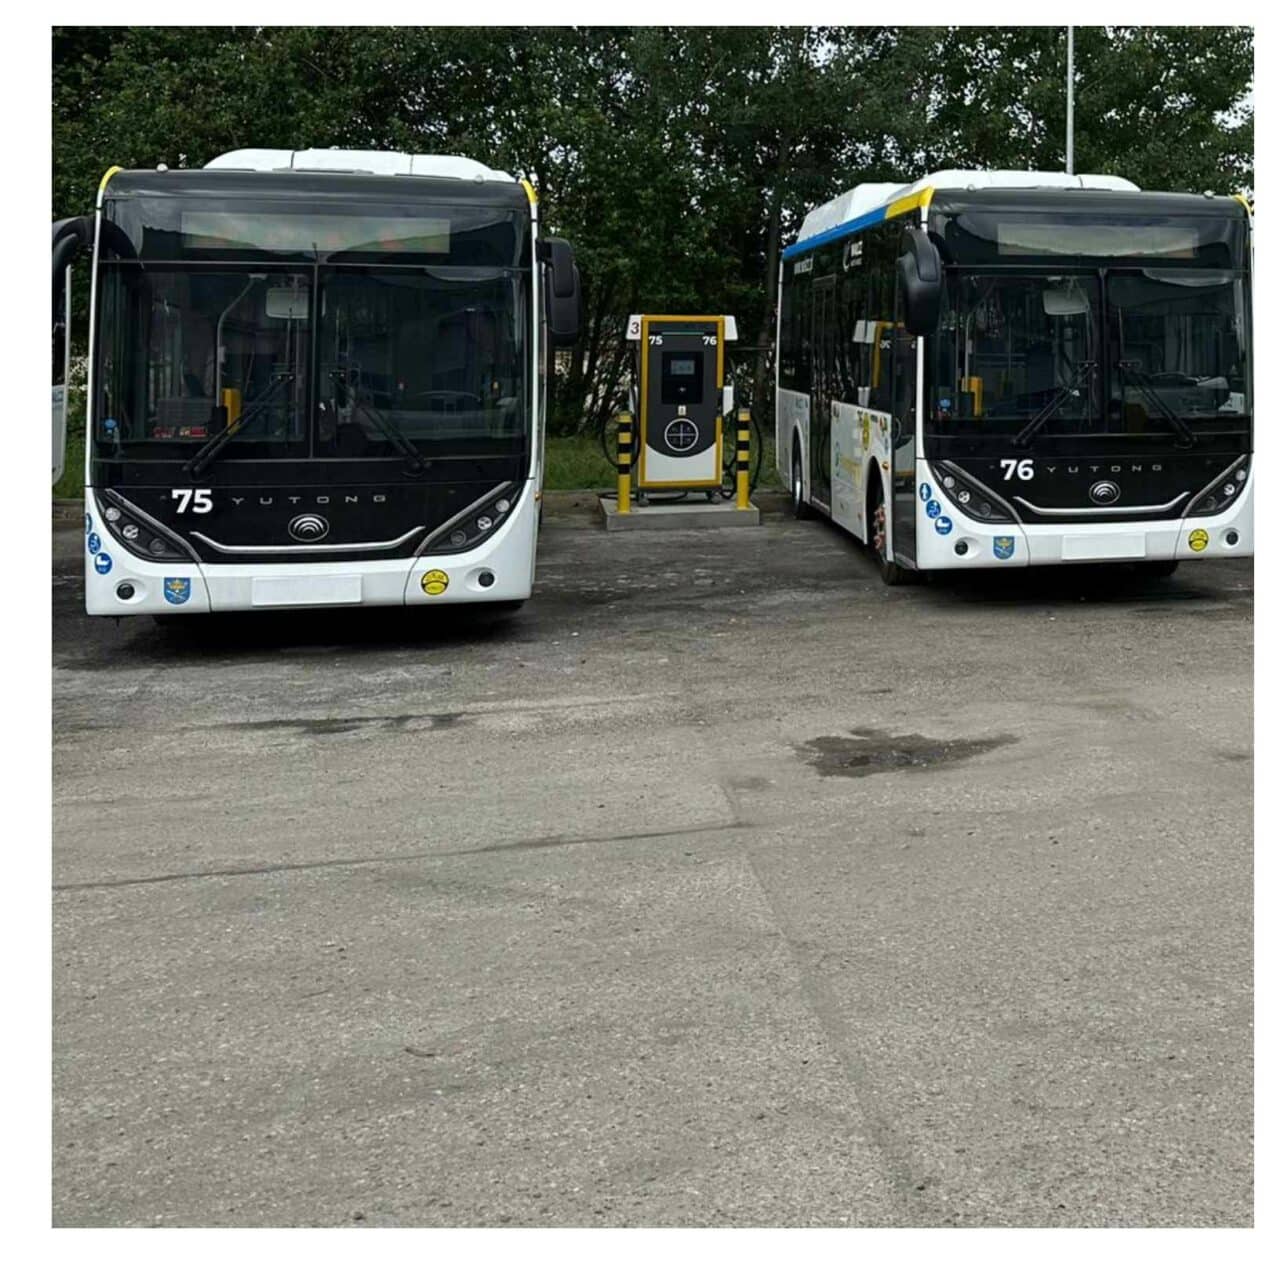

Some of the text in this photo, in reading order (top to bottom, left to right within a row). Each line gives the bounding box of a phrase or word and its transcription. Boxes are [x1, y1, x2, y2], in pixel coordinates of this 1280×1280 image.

[630, 322, 640, 335] 3
[648, 335, 663, 345] 75
[702, 335, 717, 345] 76
[1000, 459, 1035, 481] 76
[1046, 463, 1163, 474] YUTONG
[171, 488, 213, 514] 75
[232, 494, 387, 505] YUTONG
